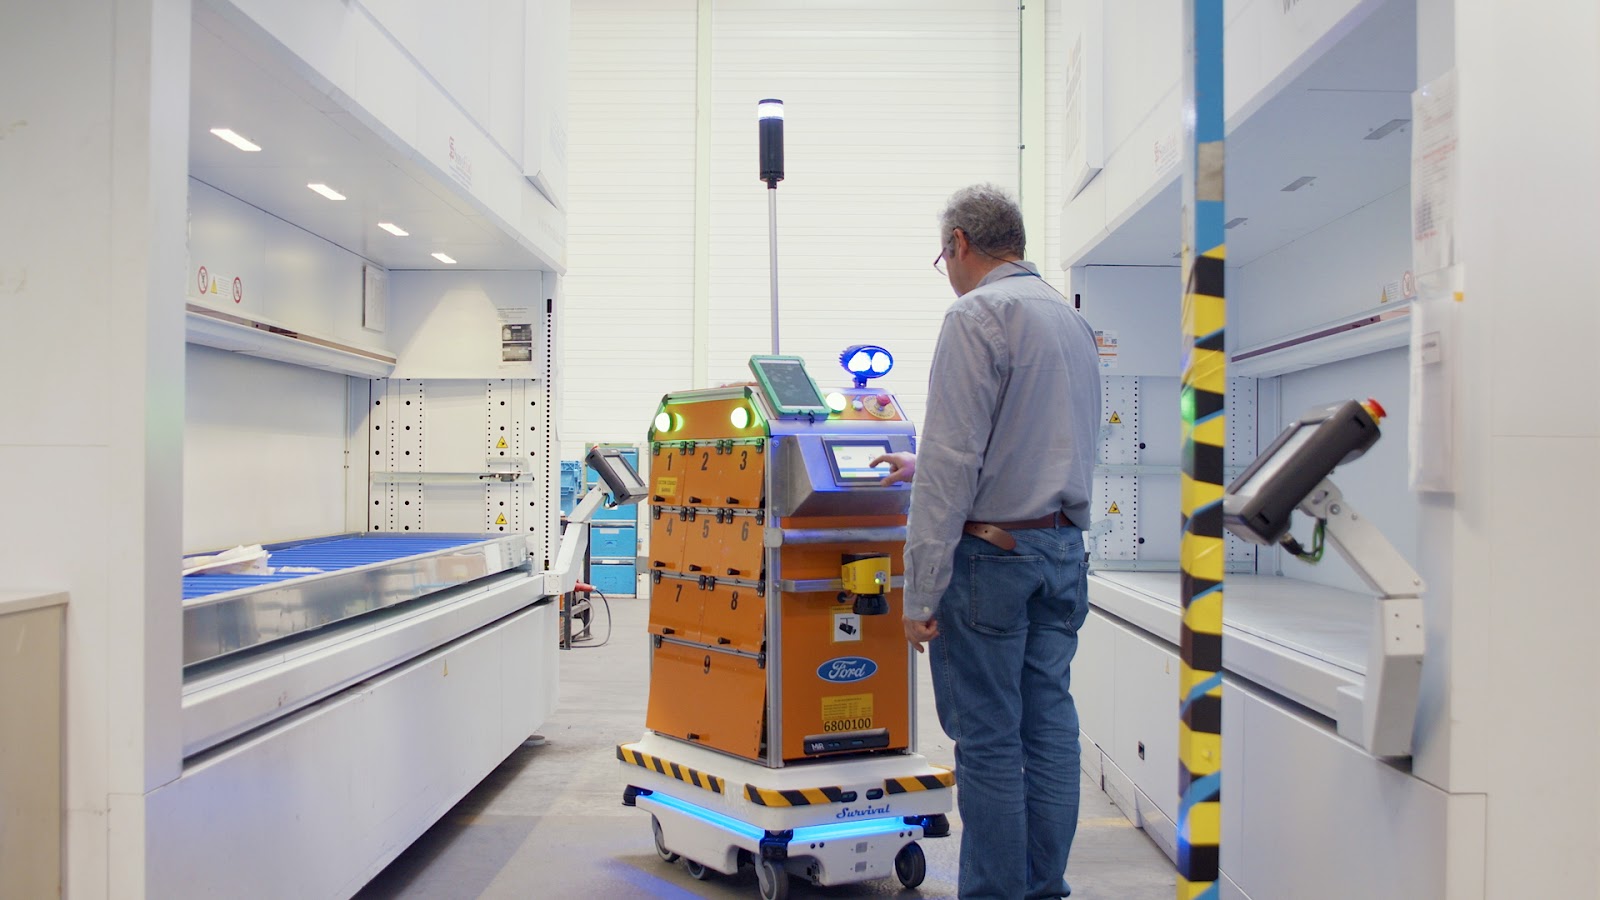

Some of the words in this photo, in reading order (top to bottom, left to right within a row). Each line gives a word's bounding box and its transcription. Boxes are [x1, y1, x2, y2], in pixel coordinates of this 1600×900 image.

[667, 452, 673, 471] 1
[701, 451, 709, 471] 2
[739, 450, 748, 471] 3
[666, 518, 673, 536] 4
[702, 519, 710, 538] 5
[741, 521, 749, 541] 6
[675, 584, 683, 603] 7
[730, 591, 739, 610] 8
[703, 655, 711, 674] 9
[828, 660, 866, 680] Ford
[823, 717, 871, 732] 6800100
[836, 803, 890, 819] Survival
